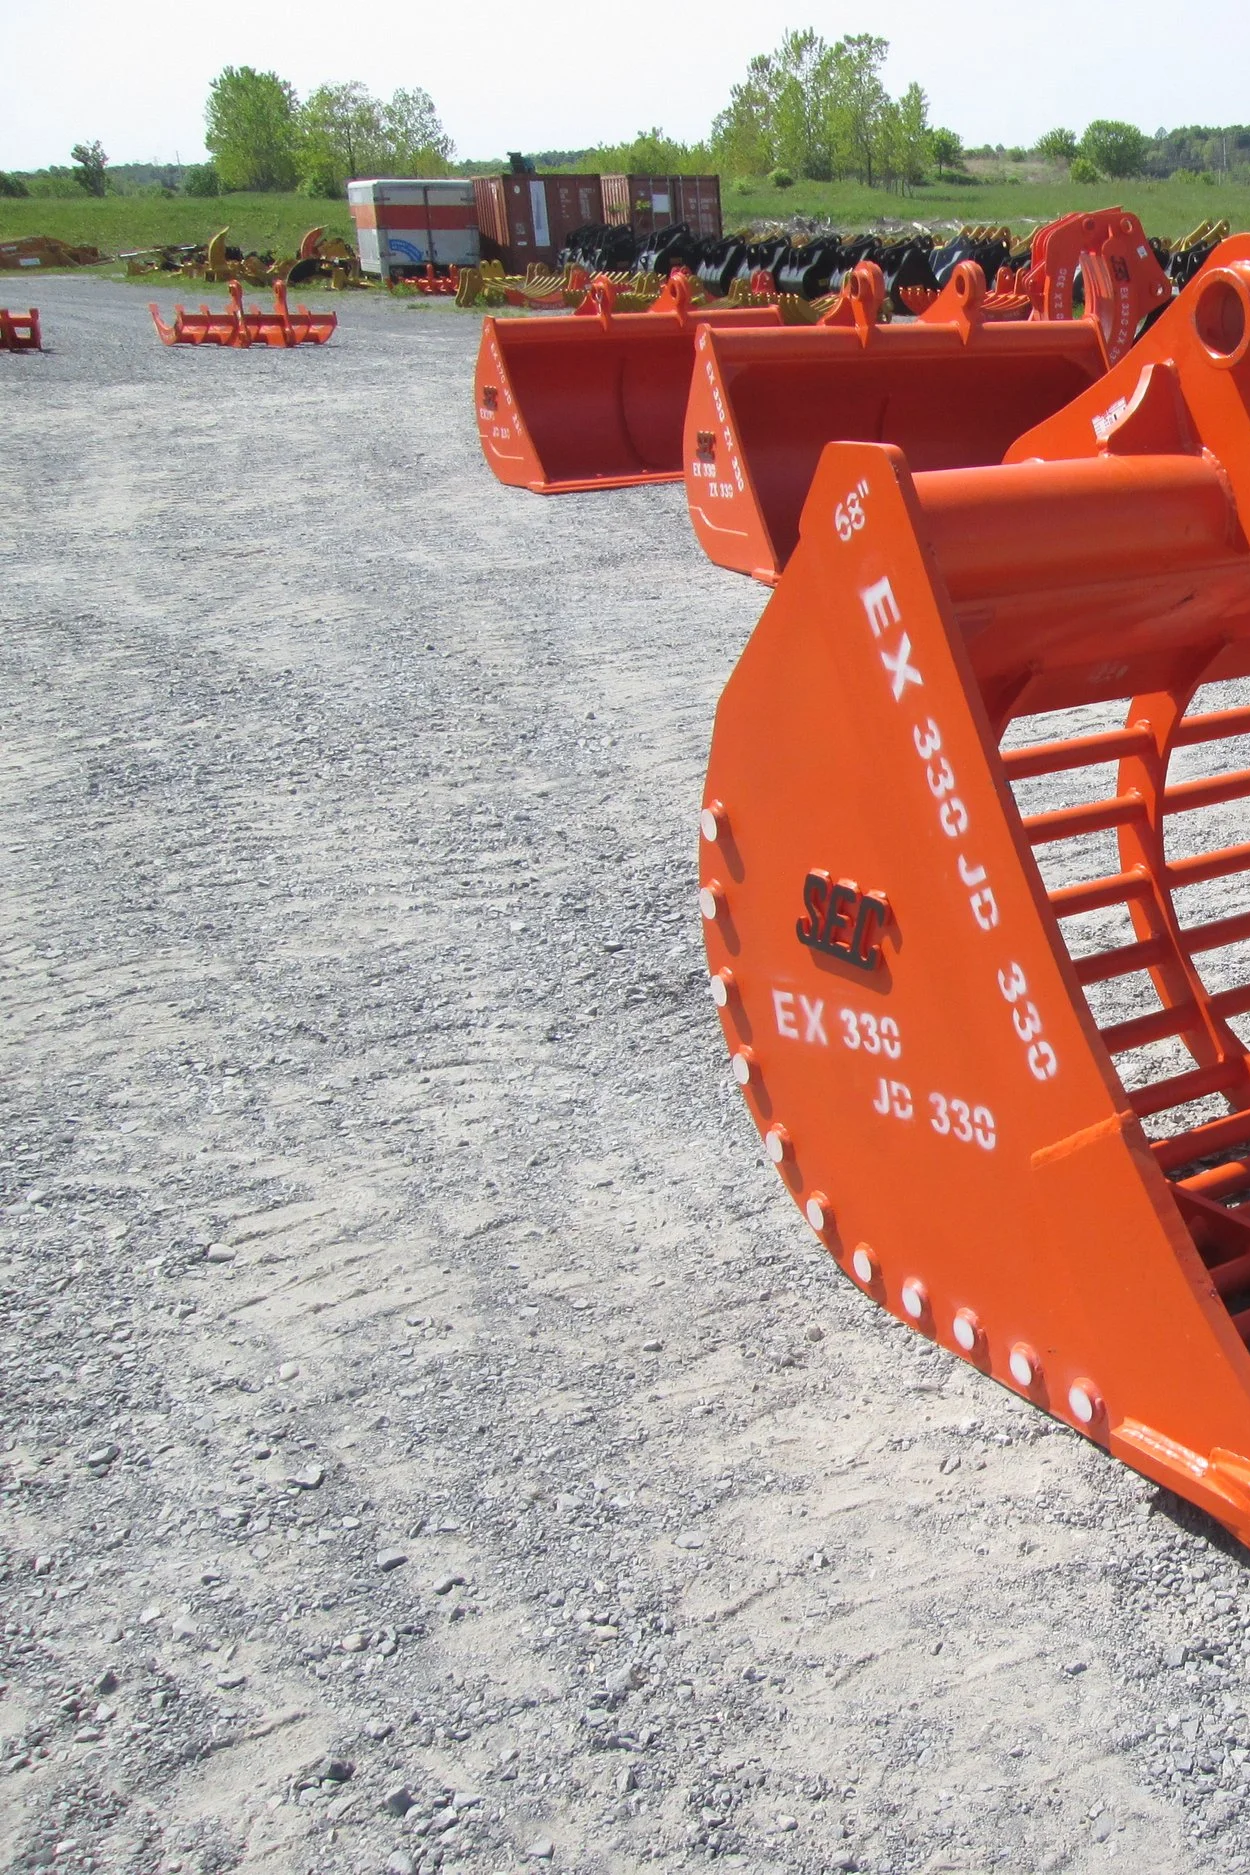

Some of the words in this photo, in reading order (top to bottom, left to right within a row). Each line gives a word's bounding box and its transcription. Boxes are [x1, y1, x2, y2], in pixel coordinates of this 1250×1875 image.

[705, 361, 716, 385] EX
[713, 387, 726, 423] 330
[731, 456, 745, 492] 330
[693, 462, 701, 477] EX
[703, 463, 717, 478] 330
[709, 482, 719, 497] ZX
[719, 483, 734, 499] 330
[860, 574, 923, 703] EX
[912, 717, 969, 838] 330
[957, 854, 999, 931] JD
[997, 961, 1058, 1081] 330
[796, 868, 889, 972] SEC
[772, 989, 828, 1046] EX
[839, 1008, 902, 1059] 330
[873, 1077, 913, 1120] JD
[928, 1092, 997, 1151] 330
